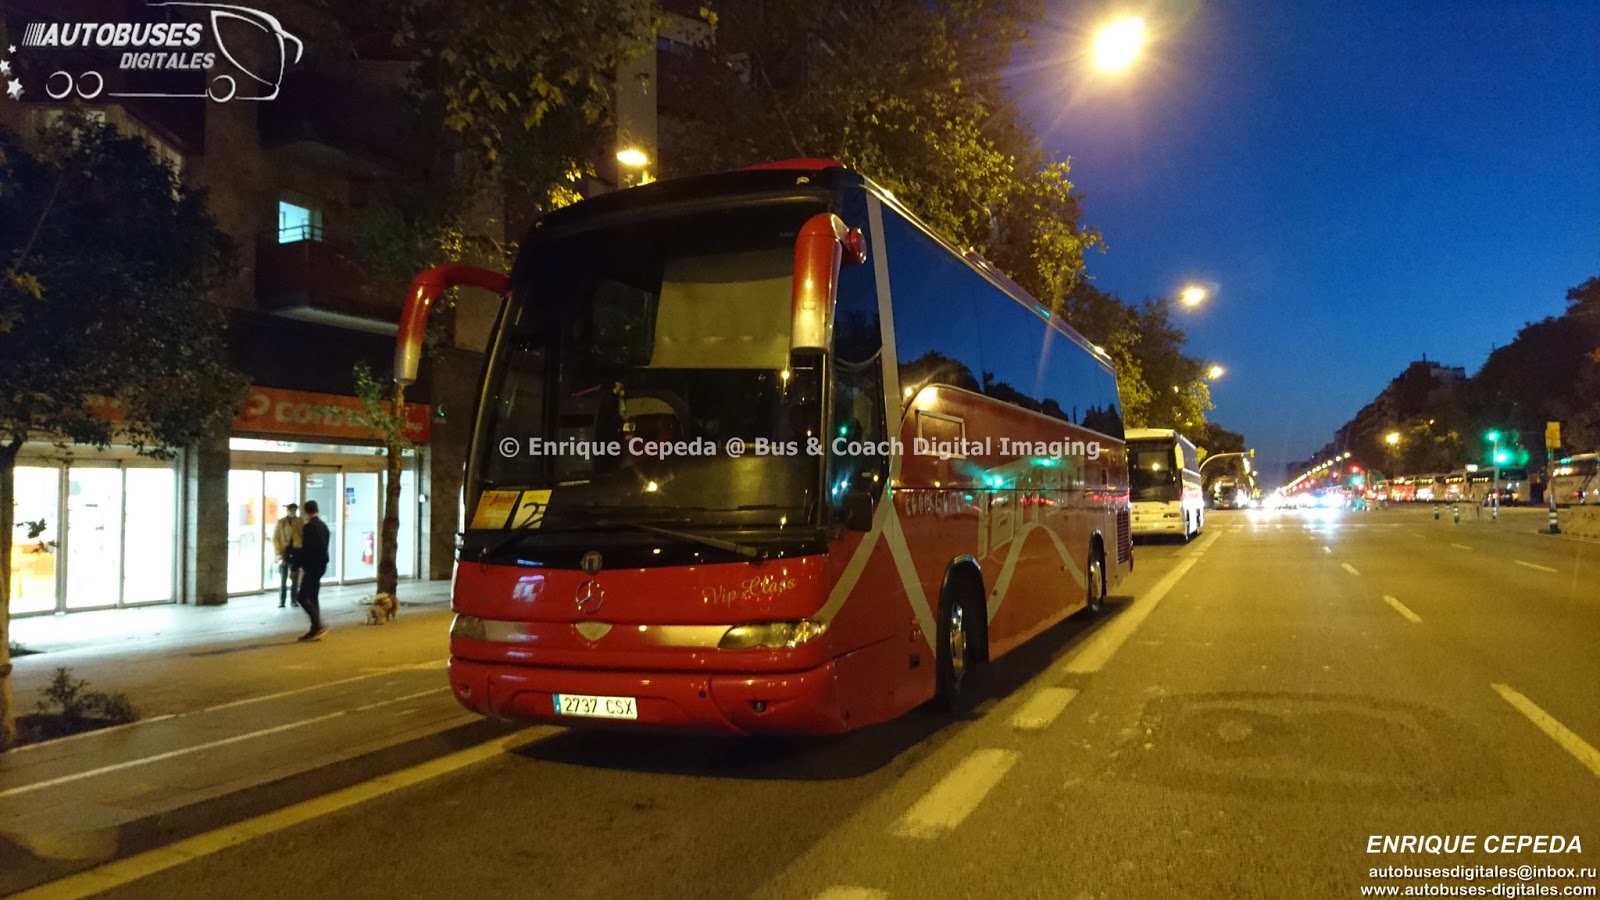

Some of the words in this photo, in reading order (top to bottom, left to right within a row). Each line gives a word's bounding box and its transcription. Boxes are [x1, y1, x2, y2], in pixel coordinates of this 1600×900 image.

[701, 585, 737, 608] Vip
[741, 575, 795, 597] Class
[565, 697, 597, 713] 2737
[606, 699, 633, 715] CSX
